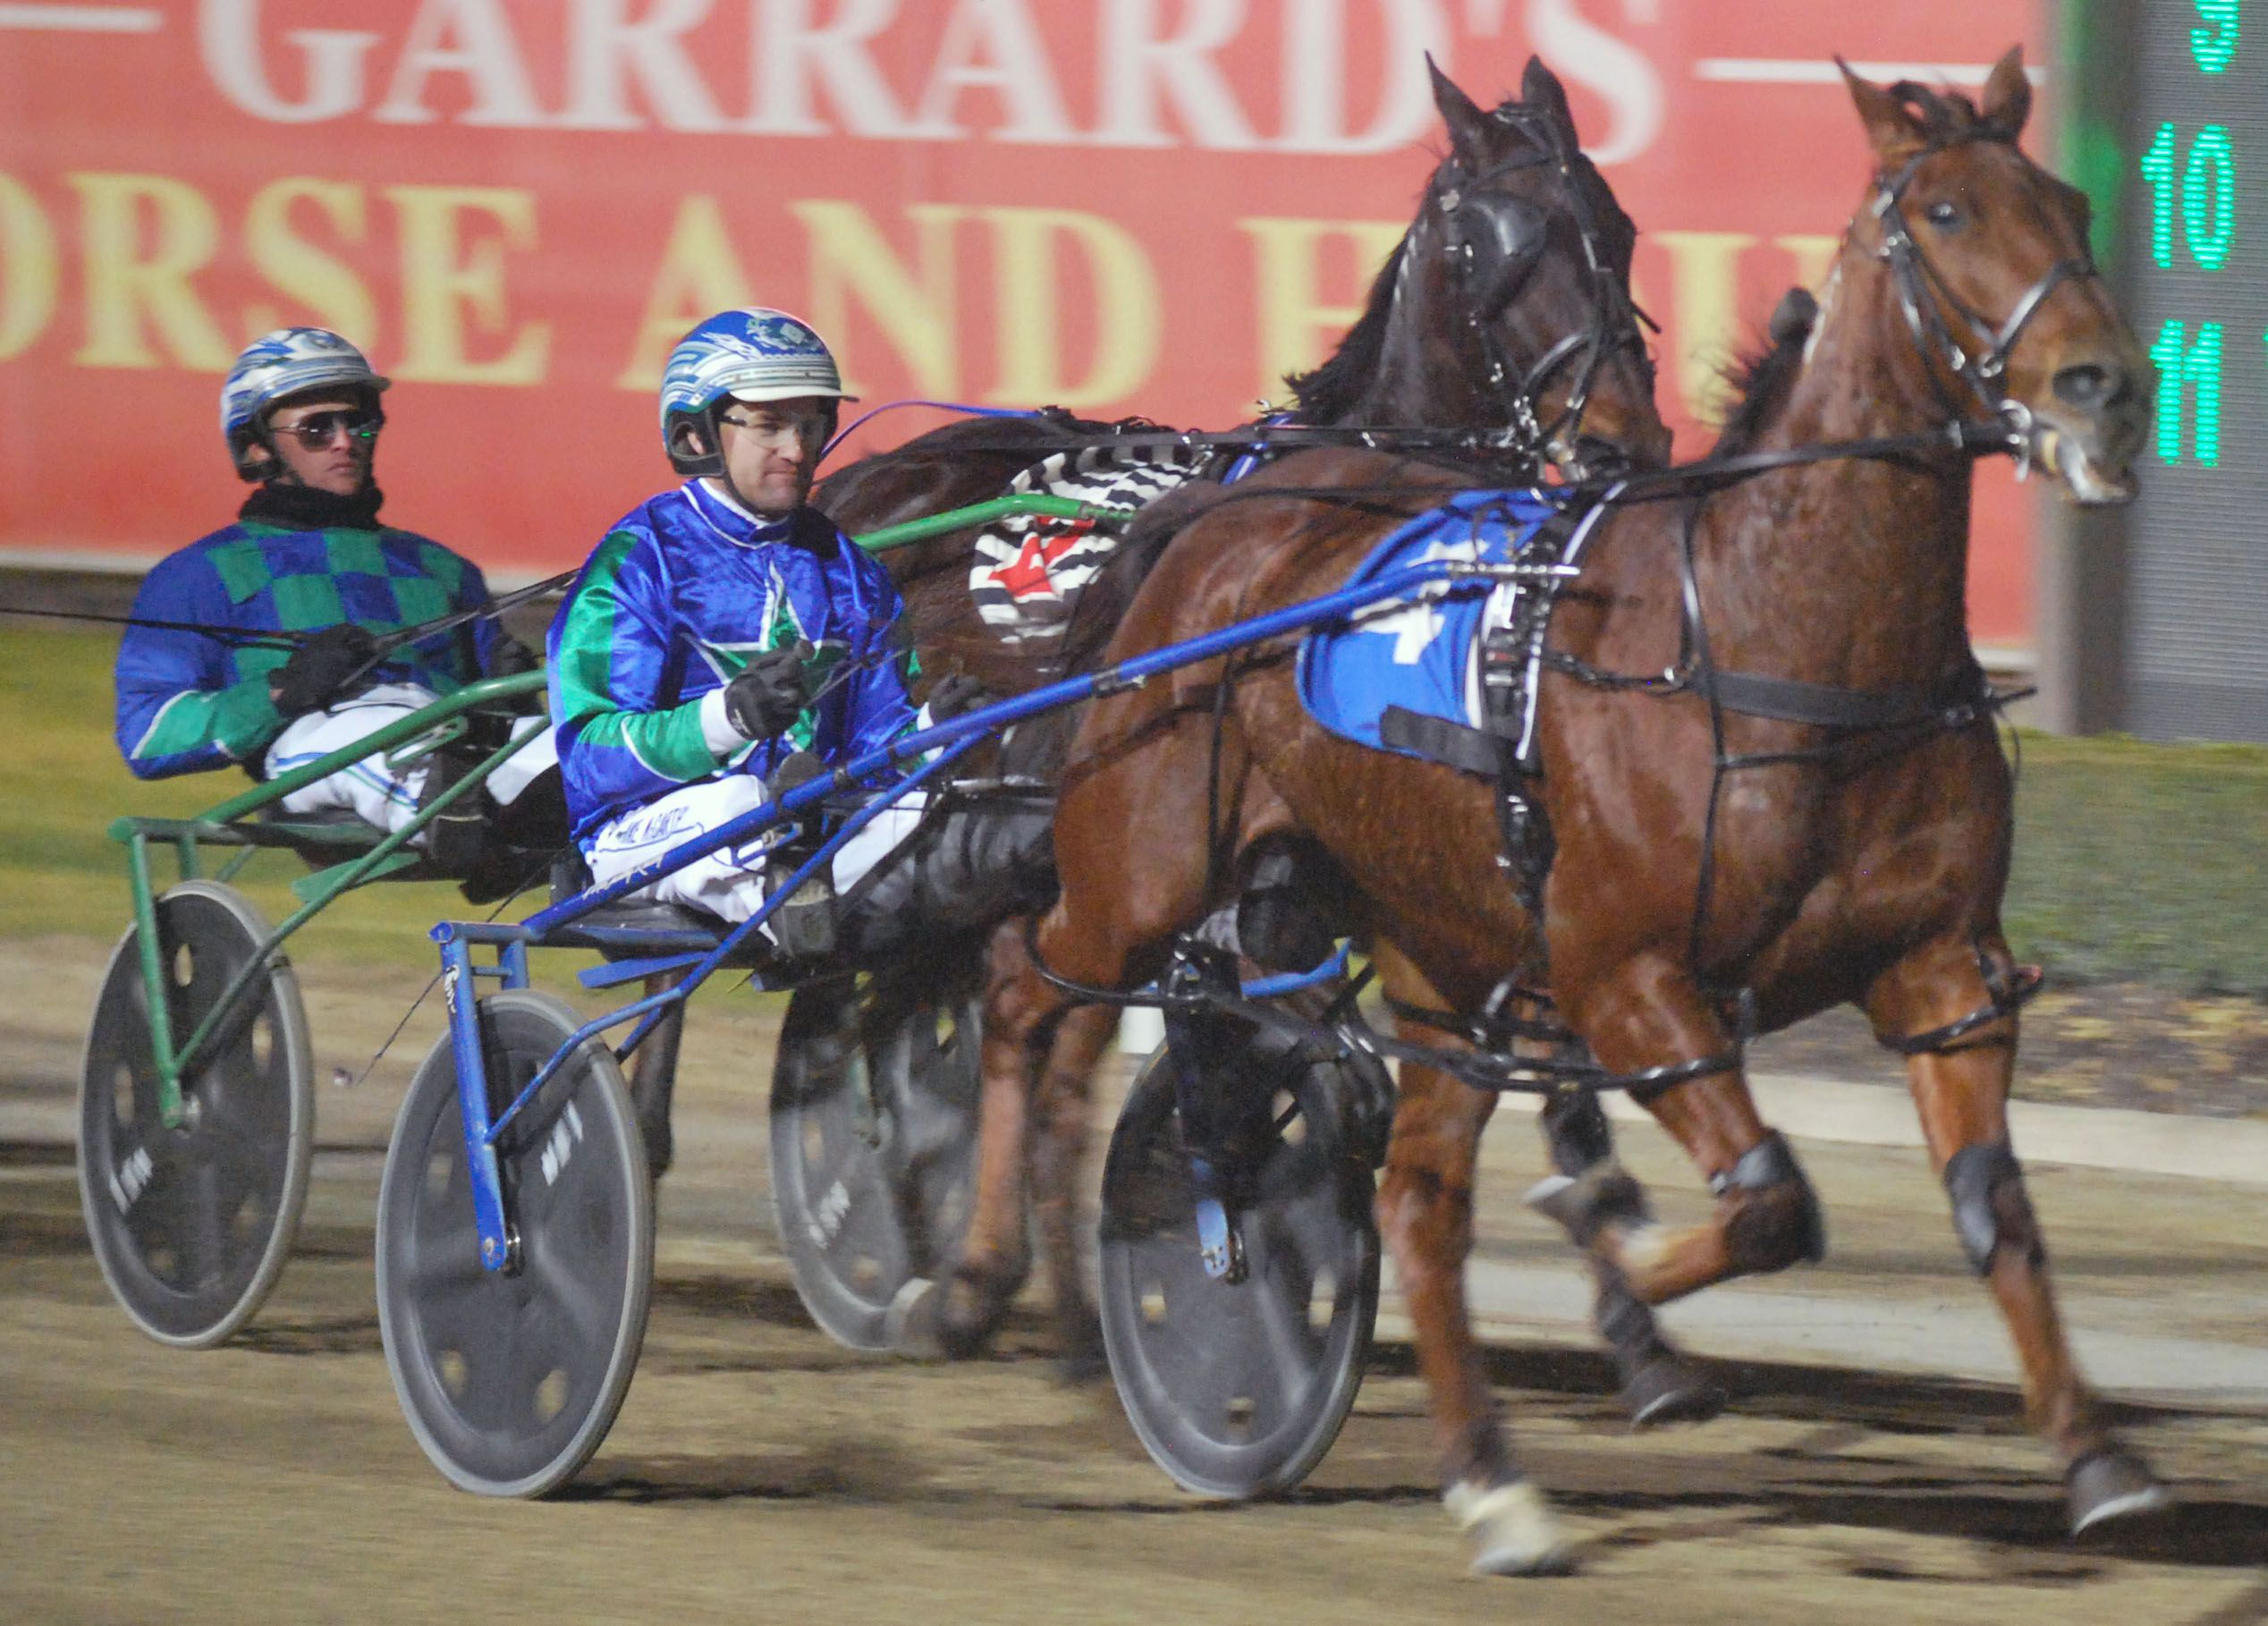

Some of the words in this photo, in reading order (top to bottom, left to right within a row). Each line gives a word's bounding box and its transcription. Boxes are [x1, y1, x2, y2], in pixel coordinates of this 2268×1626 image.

[2143, 123, 2236, 269] 10
[614, 191, 1164, 410] AND
[2149, 319, 2223, 467] 11
